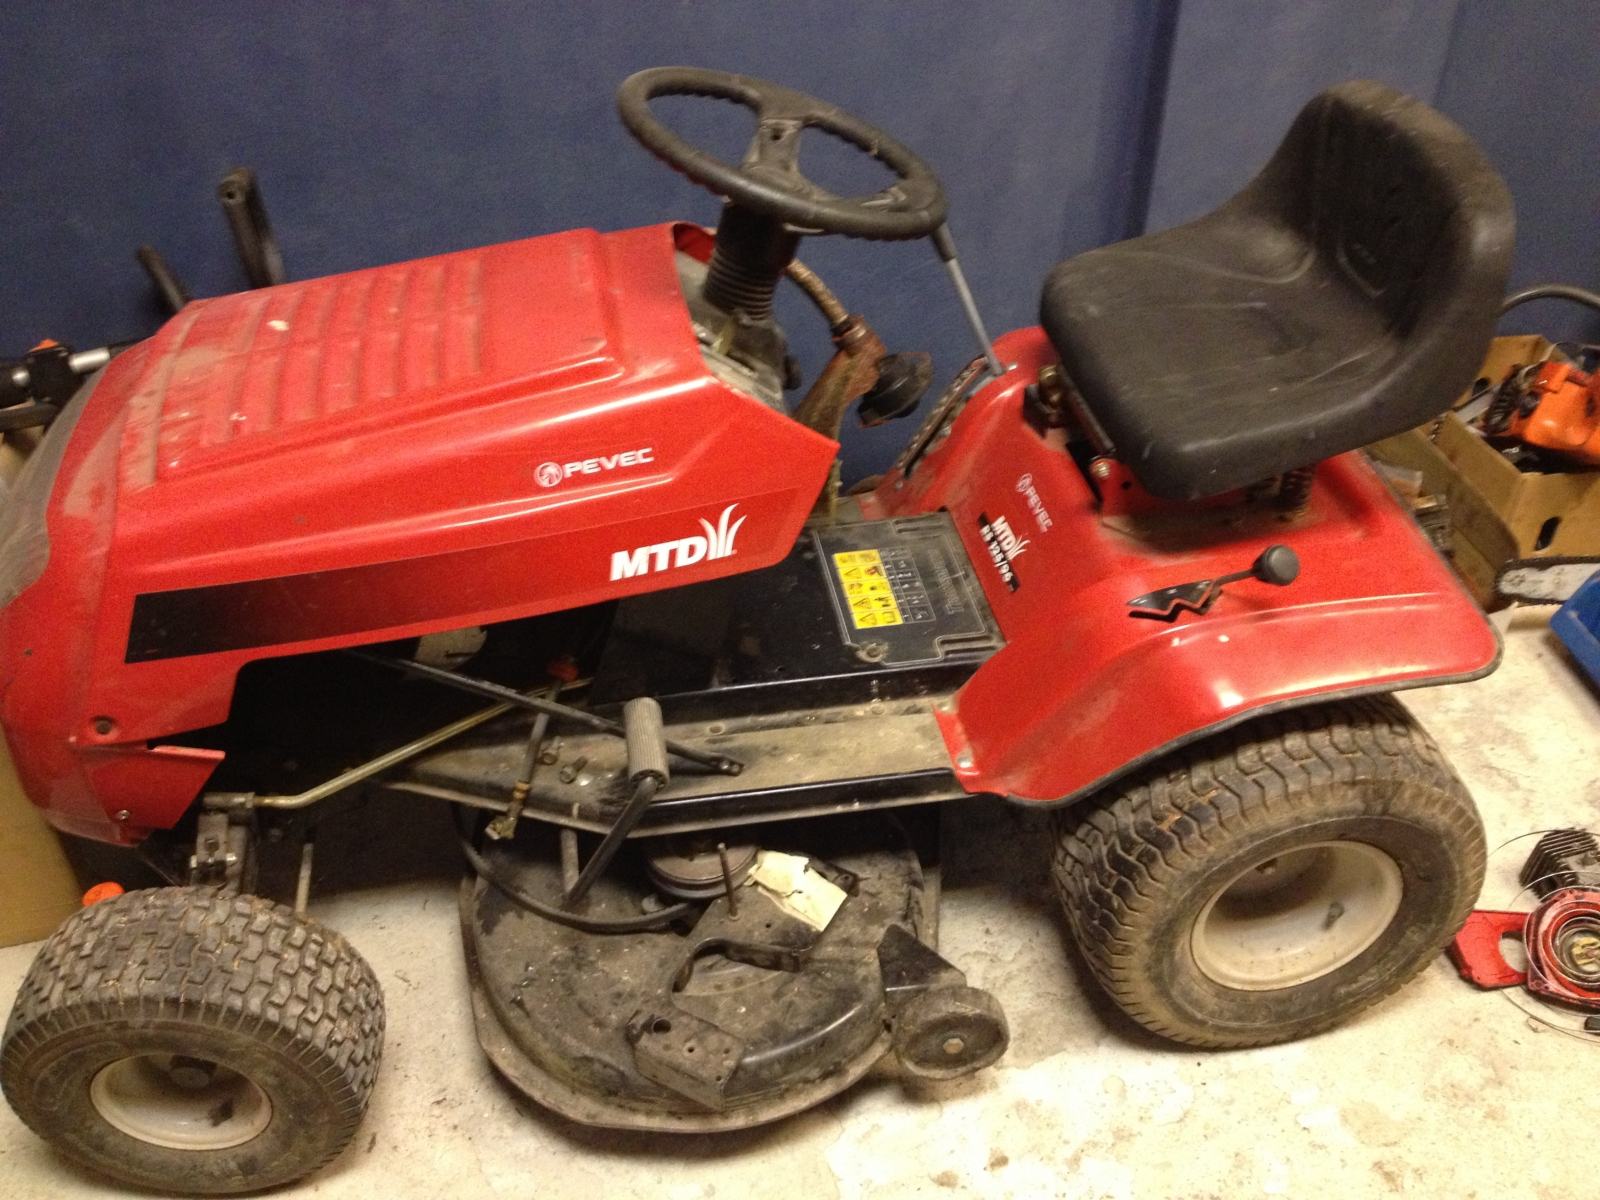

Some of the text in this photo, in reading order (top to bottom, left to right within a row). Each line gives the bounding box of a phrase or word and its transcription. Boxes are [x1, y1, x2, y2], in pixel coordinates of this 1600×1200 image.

[563, 447, 654, 478] PEVEC
[1023, 485, 1053, 533] PEVEC
[991, 515, 1017, 551] MTD
[609, 535, 708, 581] MTD
